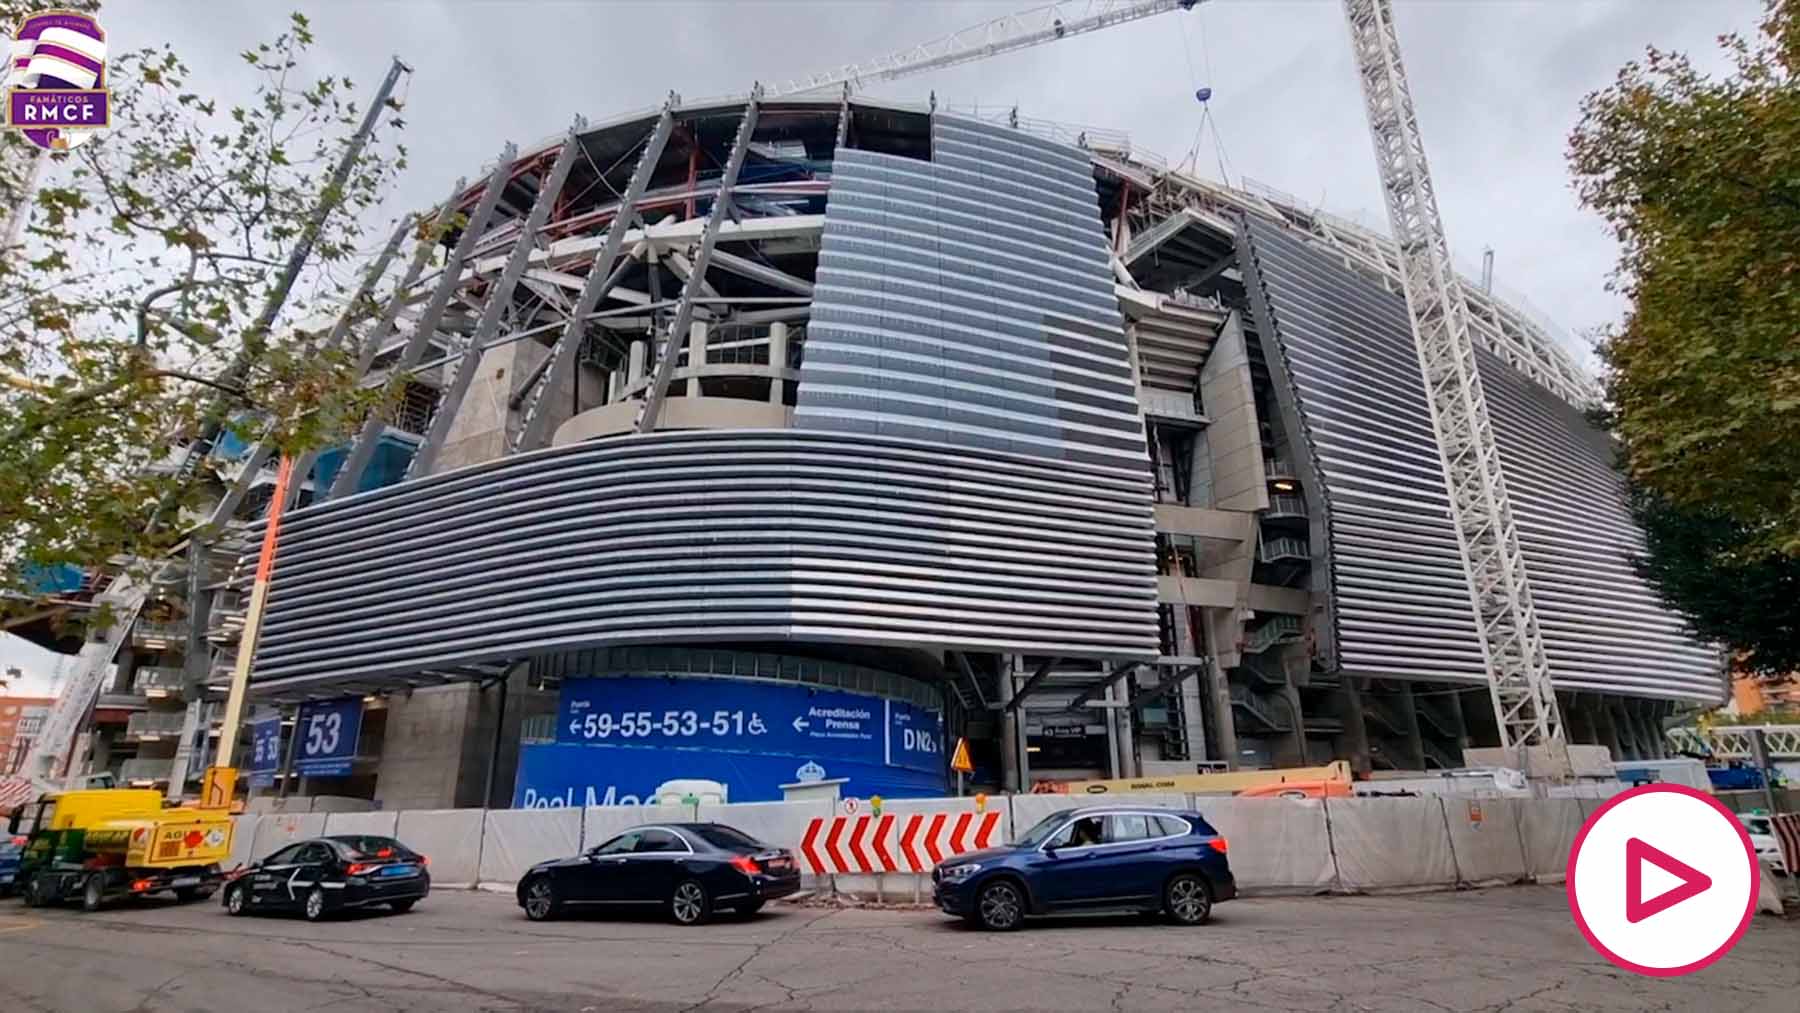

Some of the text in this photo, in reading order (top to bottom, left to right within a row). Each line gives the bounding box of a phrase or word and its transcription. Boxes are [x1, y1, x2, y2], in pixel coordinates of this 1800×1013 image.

[808, 706, 871, 719] Acreditación
[305, 711, 342, 756] 53
[583, 710, 744, 739] 59-55-53-51
[825, 718, 860, 731] Prensa
